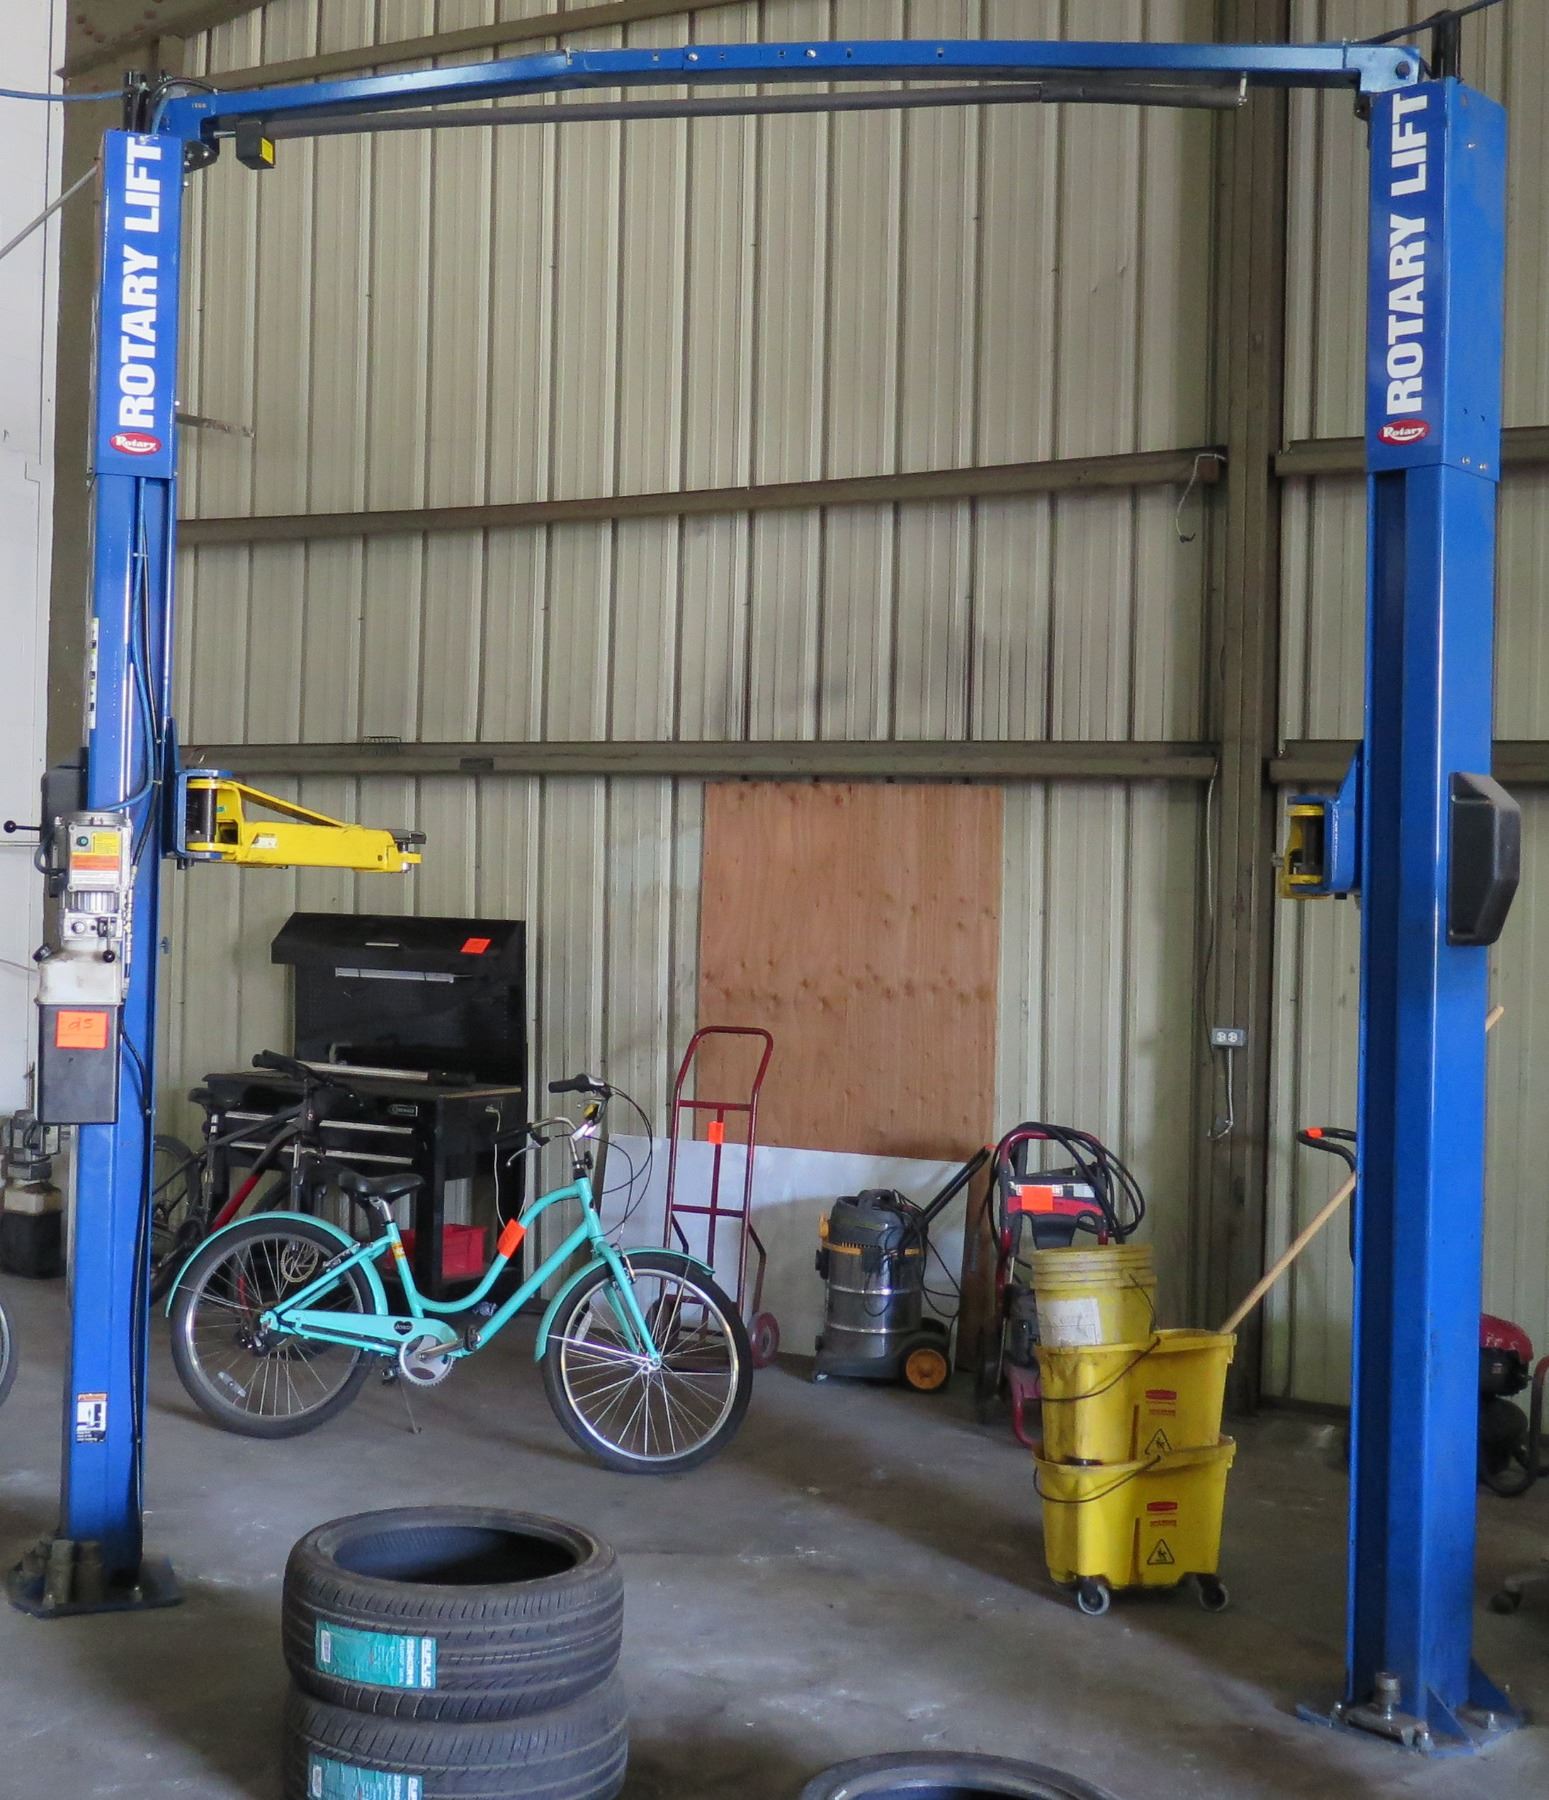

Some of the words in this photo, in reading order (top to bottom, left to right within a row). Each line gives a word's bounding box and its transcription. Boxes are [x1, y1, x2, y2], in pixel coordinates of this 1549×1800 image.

[123, 136, 162, 234] LIFT
[1390, 93, 1428, 197] LIFT
[118, 243, 159, 429] ROTARY
[1386, 213, 1426, 416] ROTARY
[115, 434, 157, 453] Rotary
[1383, 426, 1425, 441] Rotary
